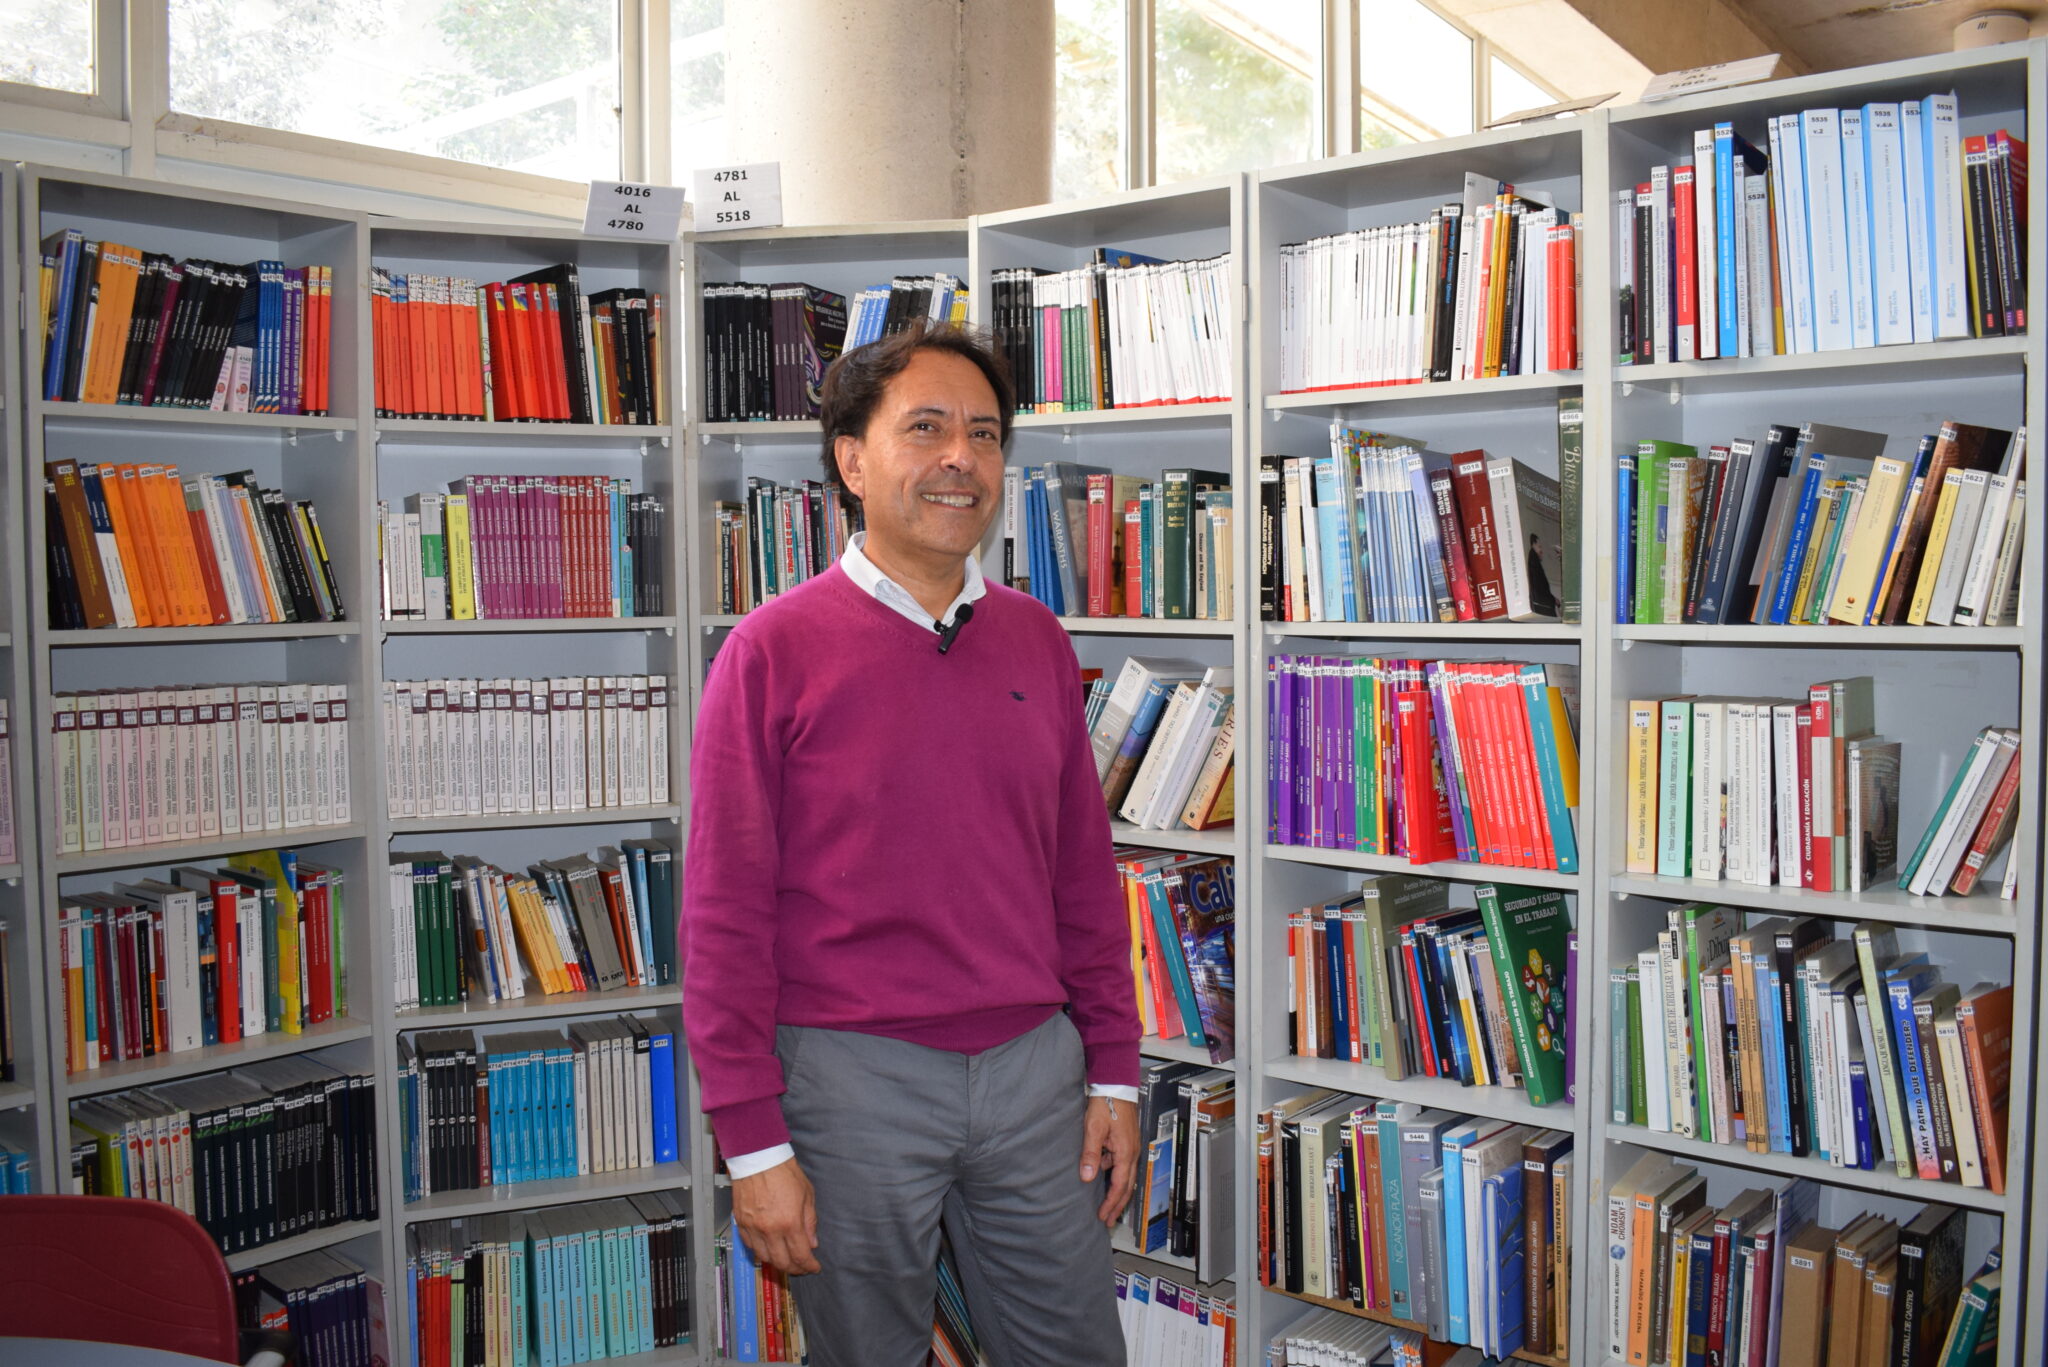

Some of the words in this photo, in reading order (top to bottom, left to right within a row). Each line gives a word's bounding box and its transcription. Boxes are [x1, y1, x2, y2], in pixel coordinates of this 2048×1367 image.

[714, 170, 748, 182] 4781
[614, 186, 651, 198] 4016
[724, 192, 740, 202] AL
[624, 204, 642, 214] AL
[716, 210, 750, 223] 5518
[608, 220, 644, 231] 4780
[1052, 510, 1068, 569] WARPATHS
[1778, 573, 1792, 610] POBLADORES
[1786, 563, 1794, 571] DE
[1504, 898, 1536, 911] SEGURIDAD
[1543, 893, 1561, 904] SALUD
[1515, 915, 1523, 924] EN
[1532, 908, 1557, 920] TRABAJO
[1504, 971, 1515, 999] TRABAJO
[1513, 1008, 1518, 1016] EN
[1516, 1019, 1524, 1037] SALUD
[1902, 1020, 1918, 1072] DEFENDER?
[1522, 1044, 1534, 1078] SEGURIDAD
[1911, 1075, 1921, 1094] QUE
[1930, 1084, 1941, 1116] ENFOQUES
[1936, 1083, 1949, 1132] RETROSPECTIVA
[1914, 1099, 1928, 1131] PATRIA
[1935, 1117, 1944, 1147] DERECHO
[1920, 1133, 1933, 1159] ¿HAY
[1390, 1179, 1400, 1211] PLAZA
[1618, 1206, 1626, 1240] CHOMSKY
[1392, 1213, 1404, 1264] NICANOR
[1901, 1245, 1921, 1255] 5887
[1793, 1259, 1812, 1268] 5891
[1711, 1298, 1719, 1332] FRANCISCO
